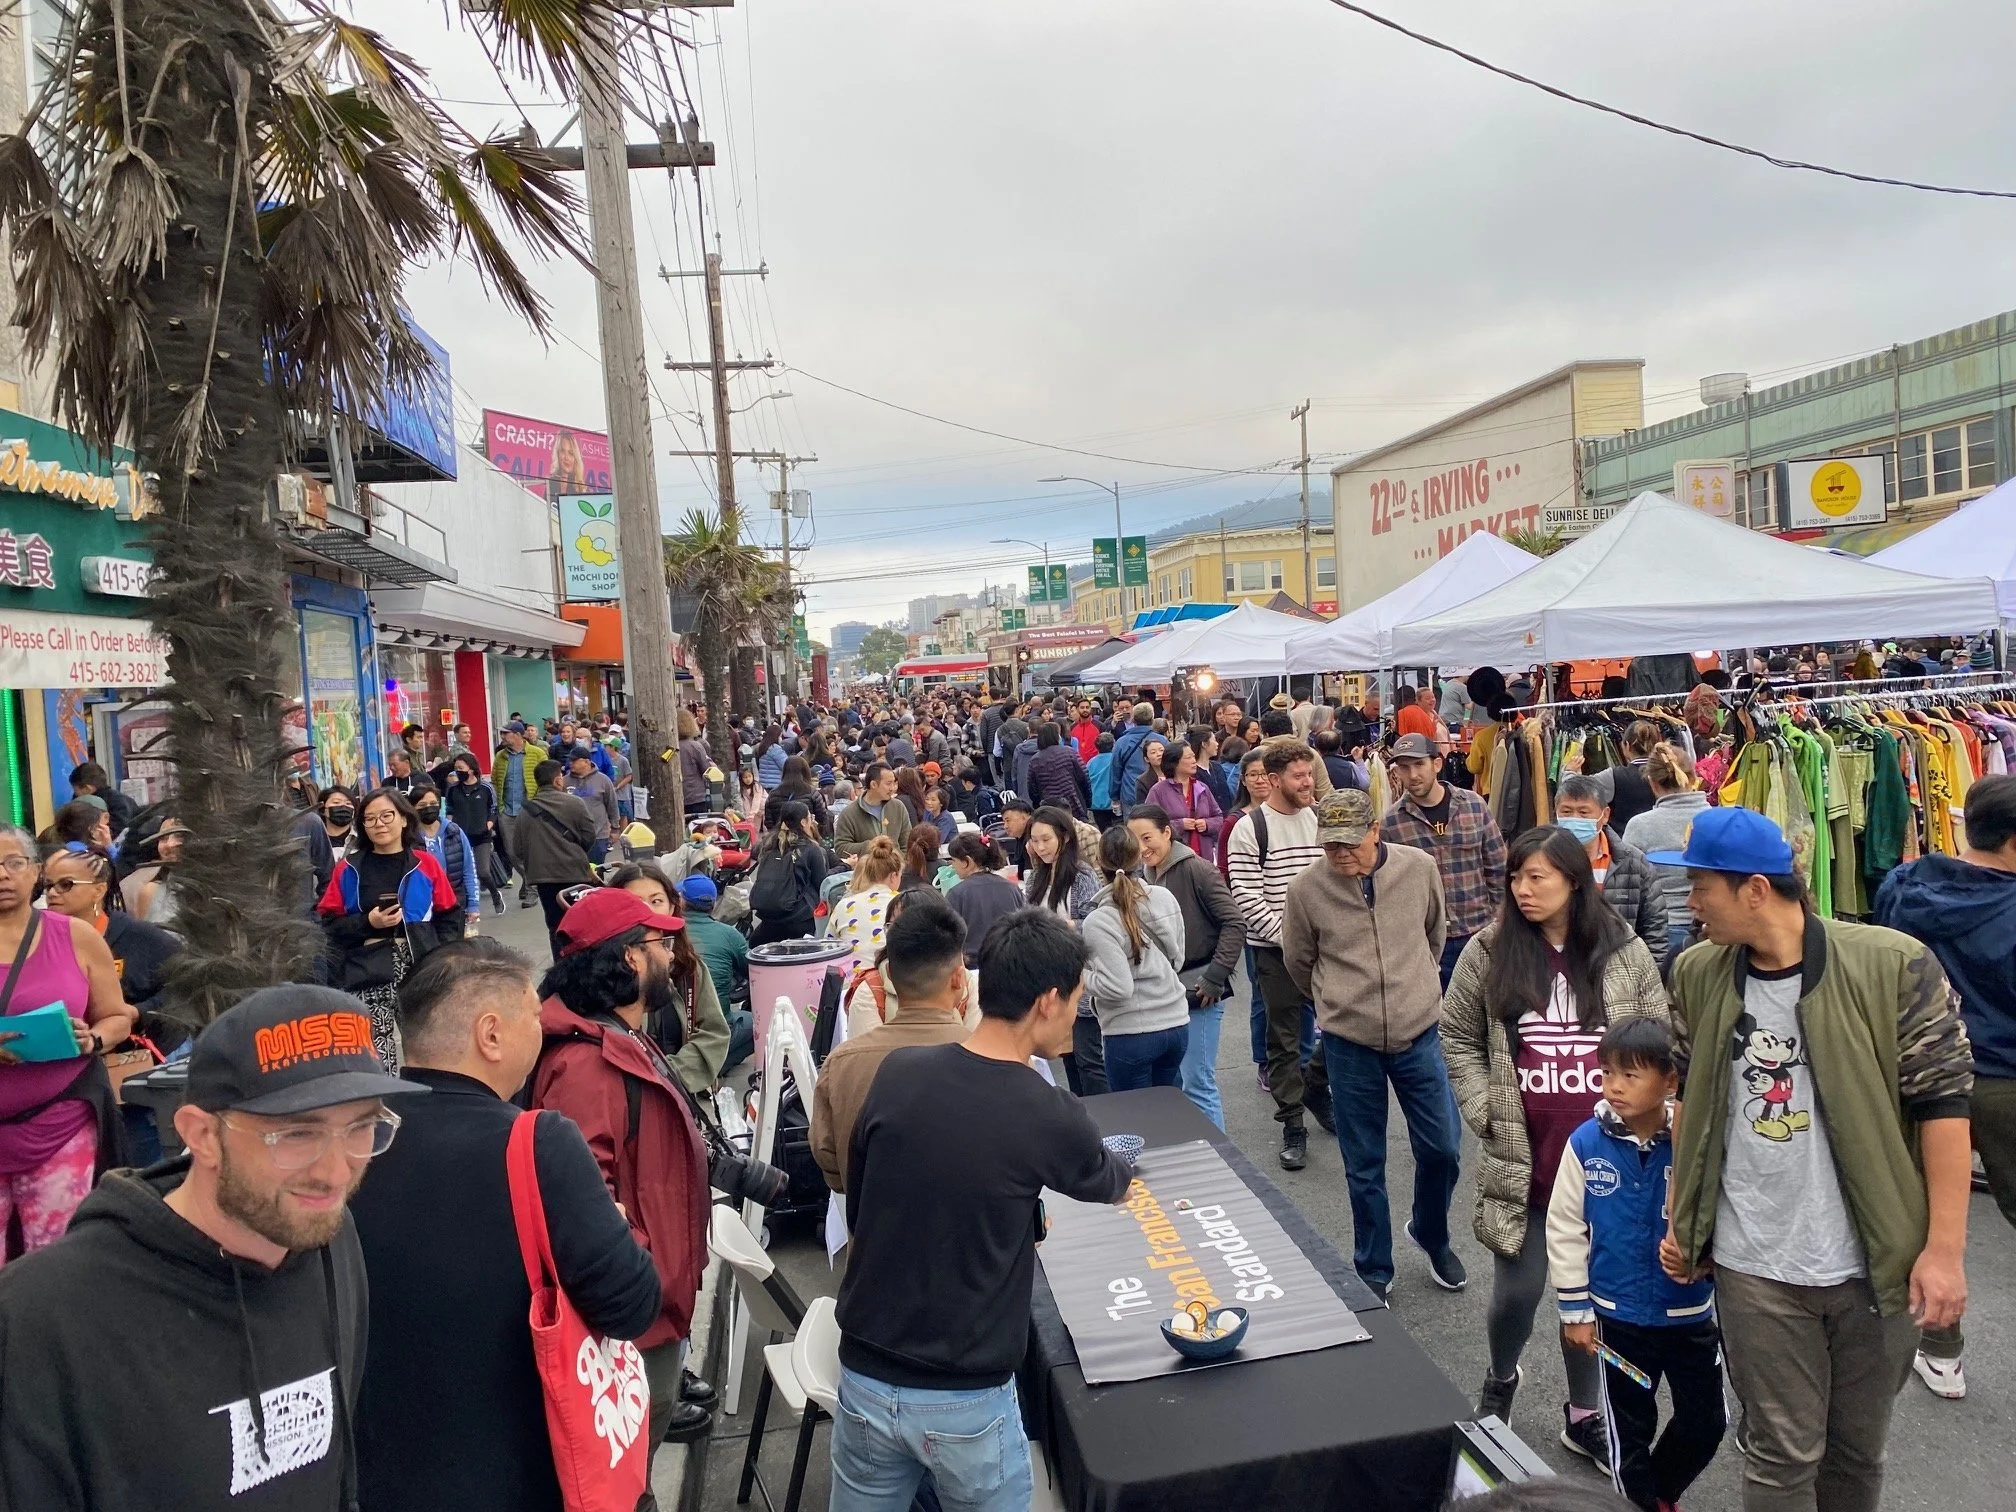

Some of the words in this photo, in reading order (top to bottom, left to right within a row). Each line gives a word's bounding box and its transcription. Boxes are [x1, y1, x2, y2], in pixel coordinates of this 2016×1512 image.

[495, 423, 554, 450] CRASH?
[582, 443, 610, 458] ASHLE
[1423, 459, 1490, 520] IRVING
[1546, 509, 1588, 522] SUNRISE
[571, 573, 600, 582] MOCHI
[592, 583, 616, 591] SHOP
[1, 624, 44, 650] Please
[48, 627, 73, 650] Call
[75, 628, 87, 651] in
[91, 630, 124, 652] Order
[127, 632, 161, 654] Before
[70, 661, 158, 683] 415-682-3828
[628, 1029, 647, 1052] Canon
[1518, 1062, 1604, 1094] adida
[1178, 1203, 1285, 1302] Standard
[1106, 1276, 1157, 1321] The
